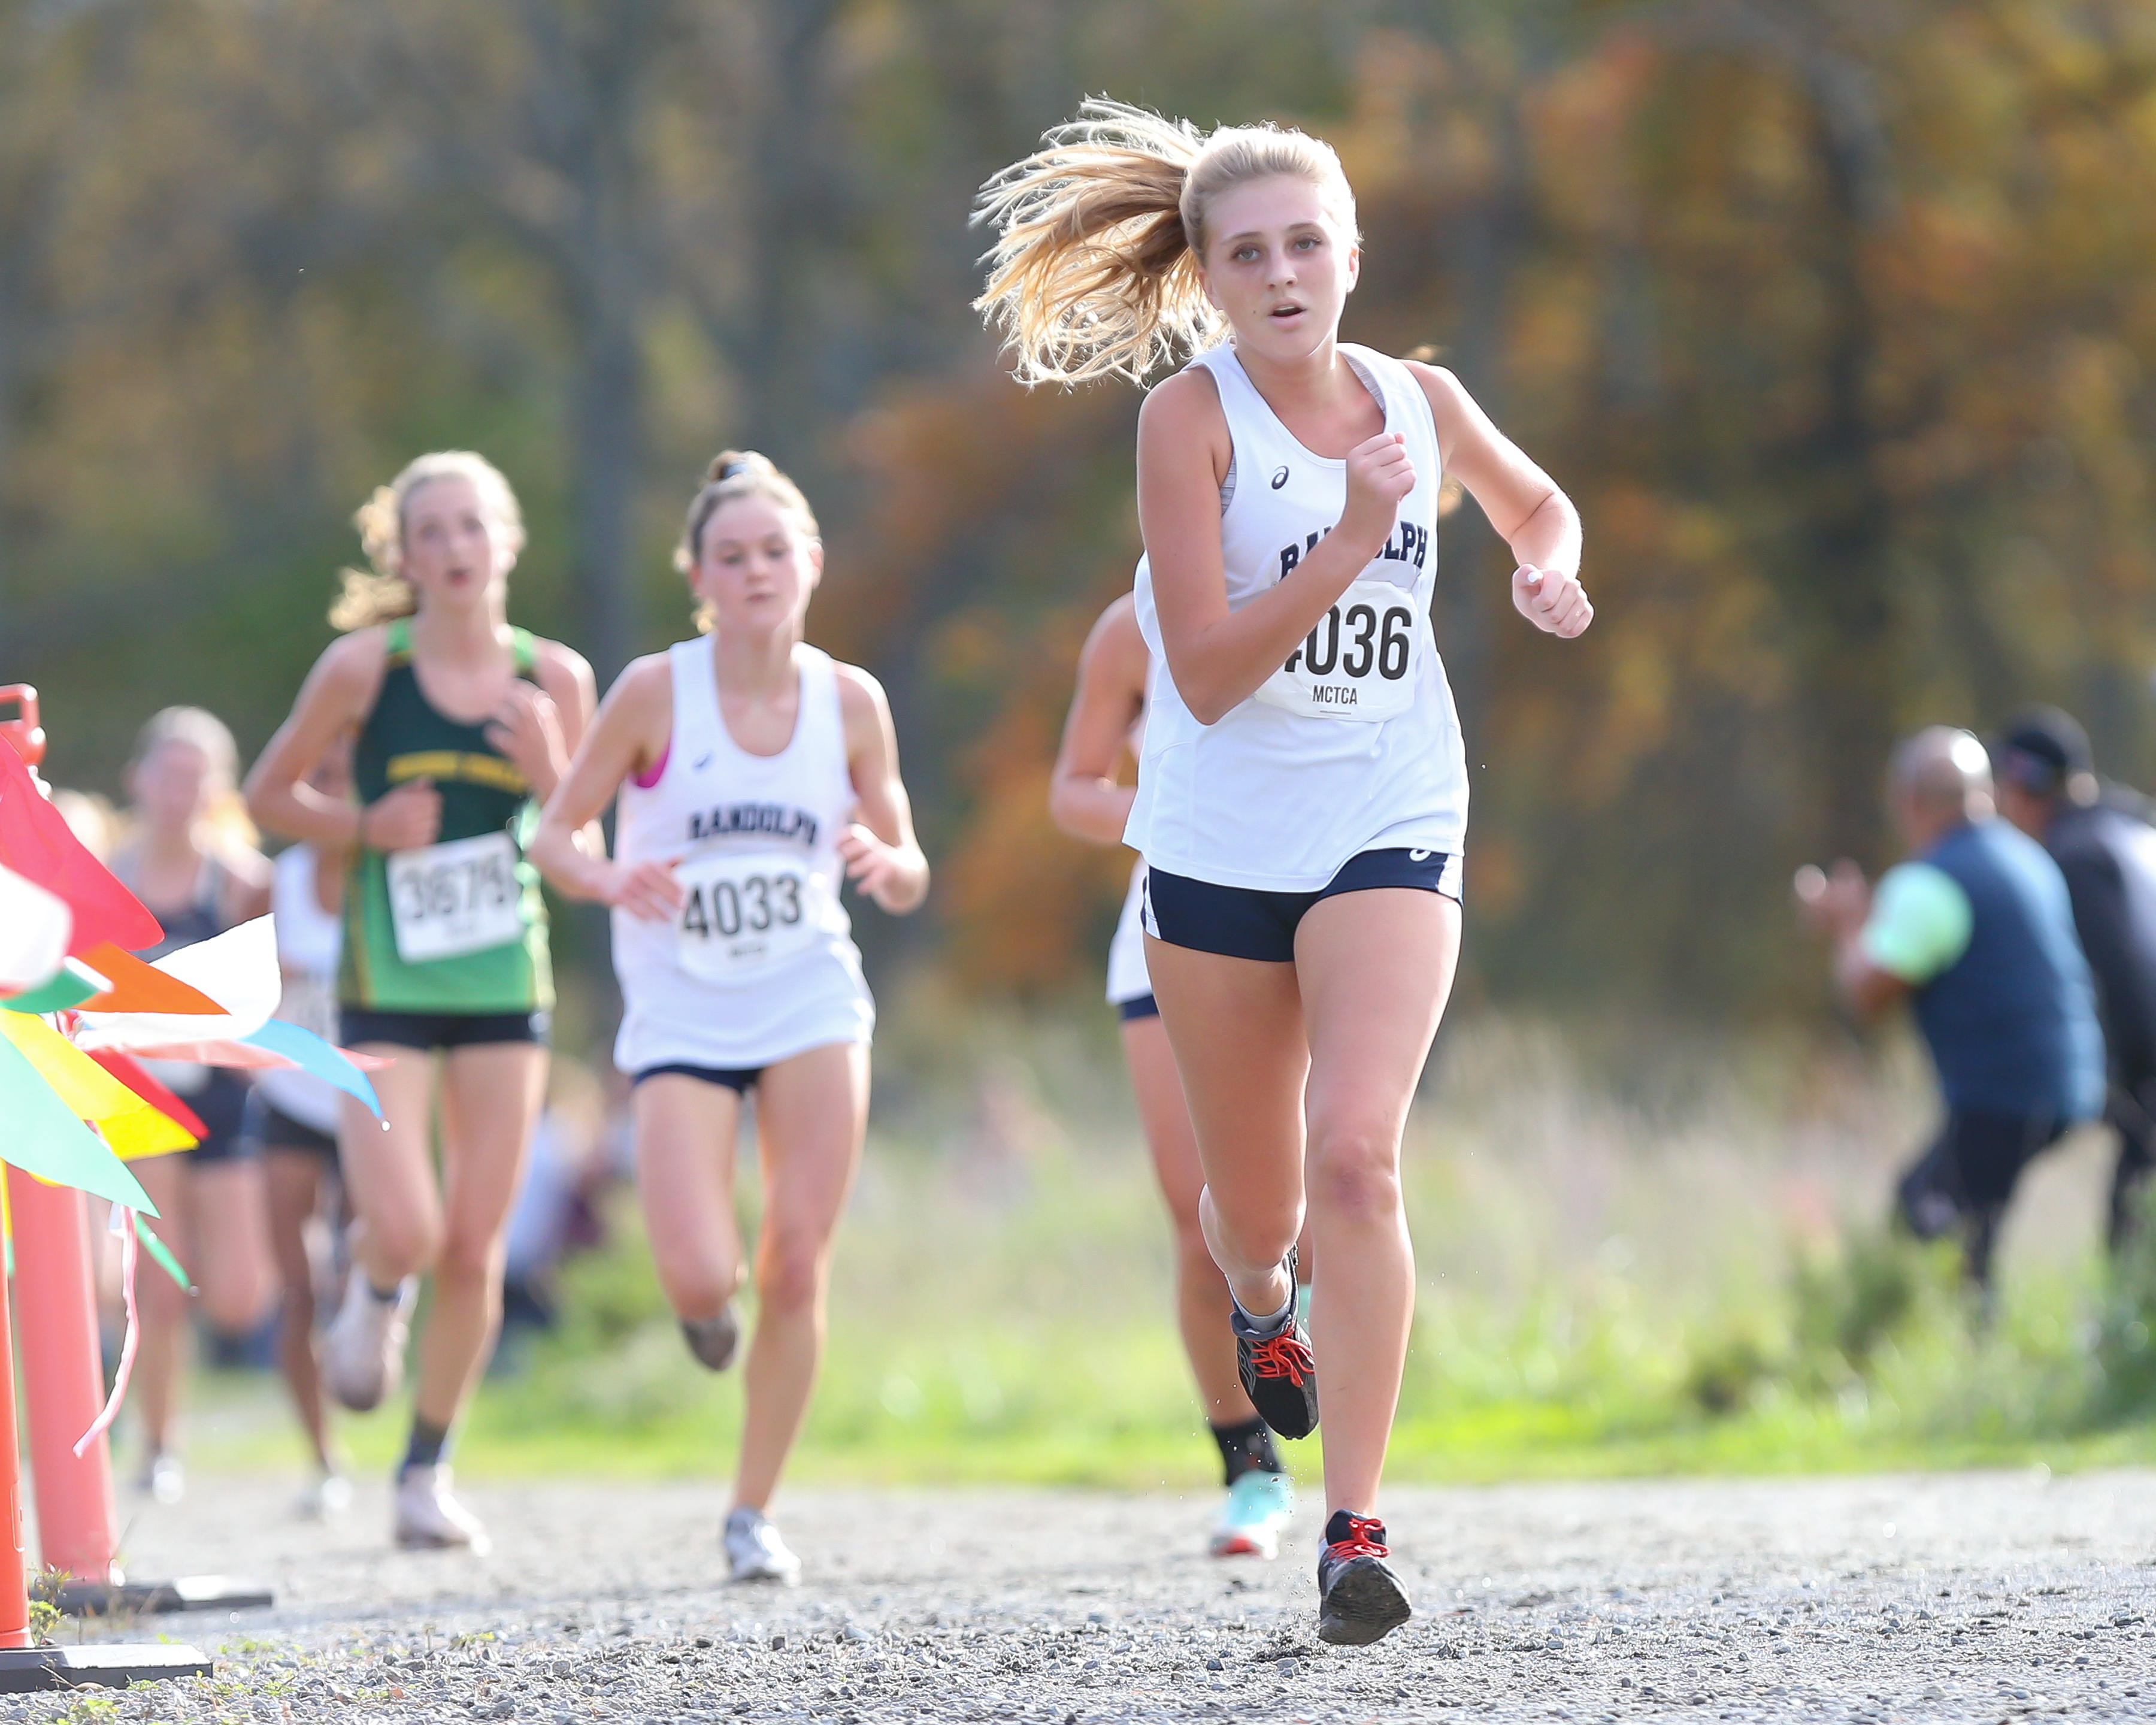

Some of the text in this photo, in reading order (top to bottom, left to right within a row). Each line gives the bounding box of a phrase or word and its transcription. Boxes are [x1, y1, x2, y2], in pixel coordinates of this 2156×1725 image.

[1280, 520, 1428, 582] RLPH
[1284, 603, 1412, 680] 036
[1312, 685, 1358, 705] MCTCA
[688, 803, 819, 847] RANDOLPH
[683, 872, 801, 939] 4033
